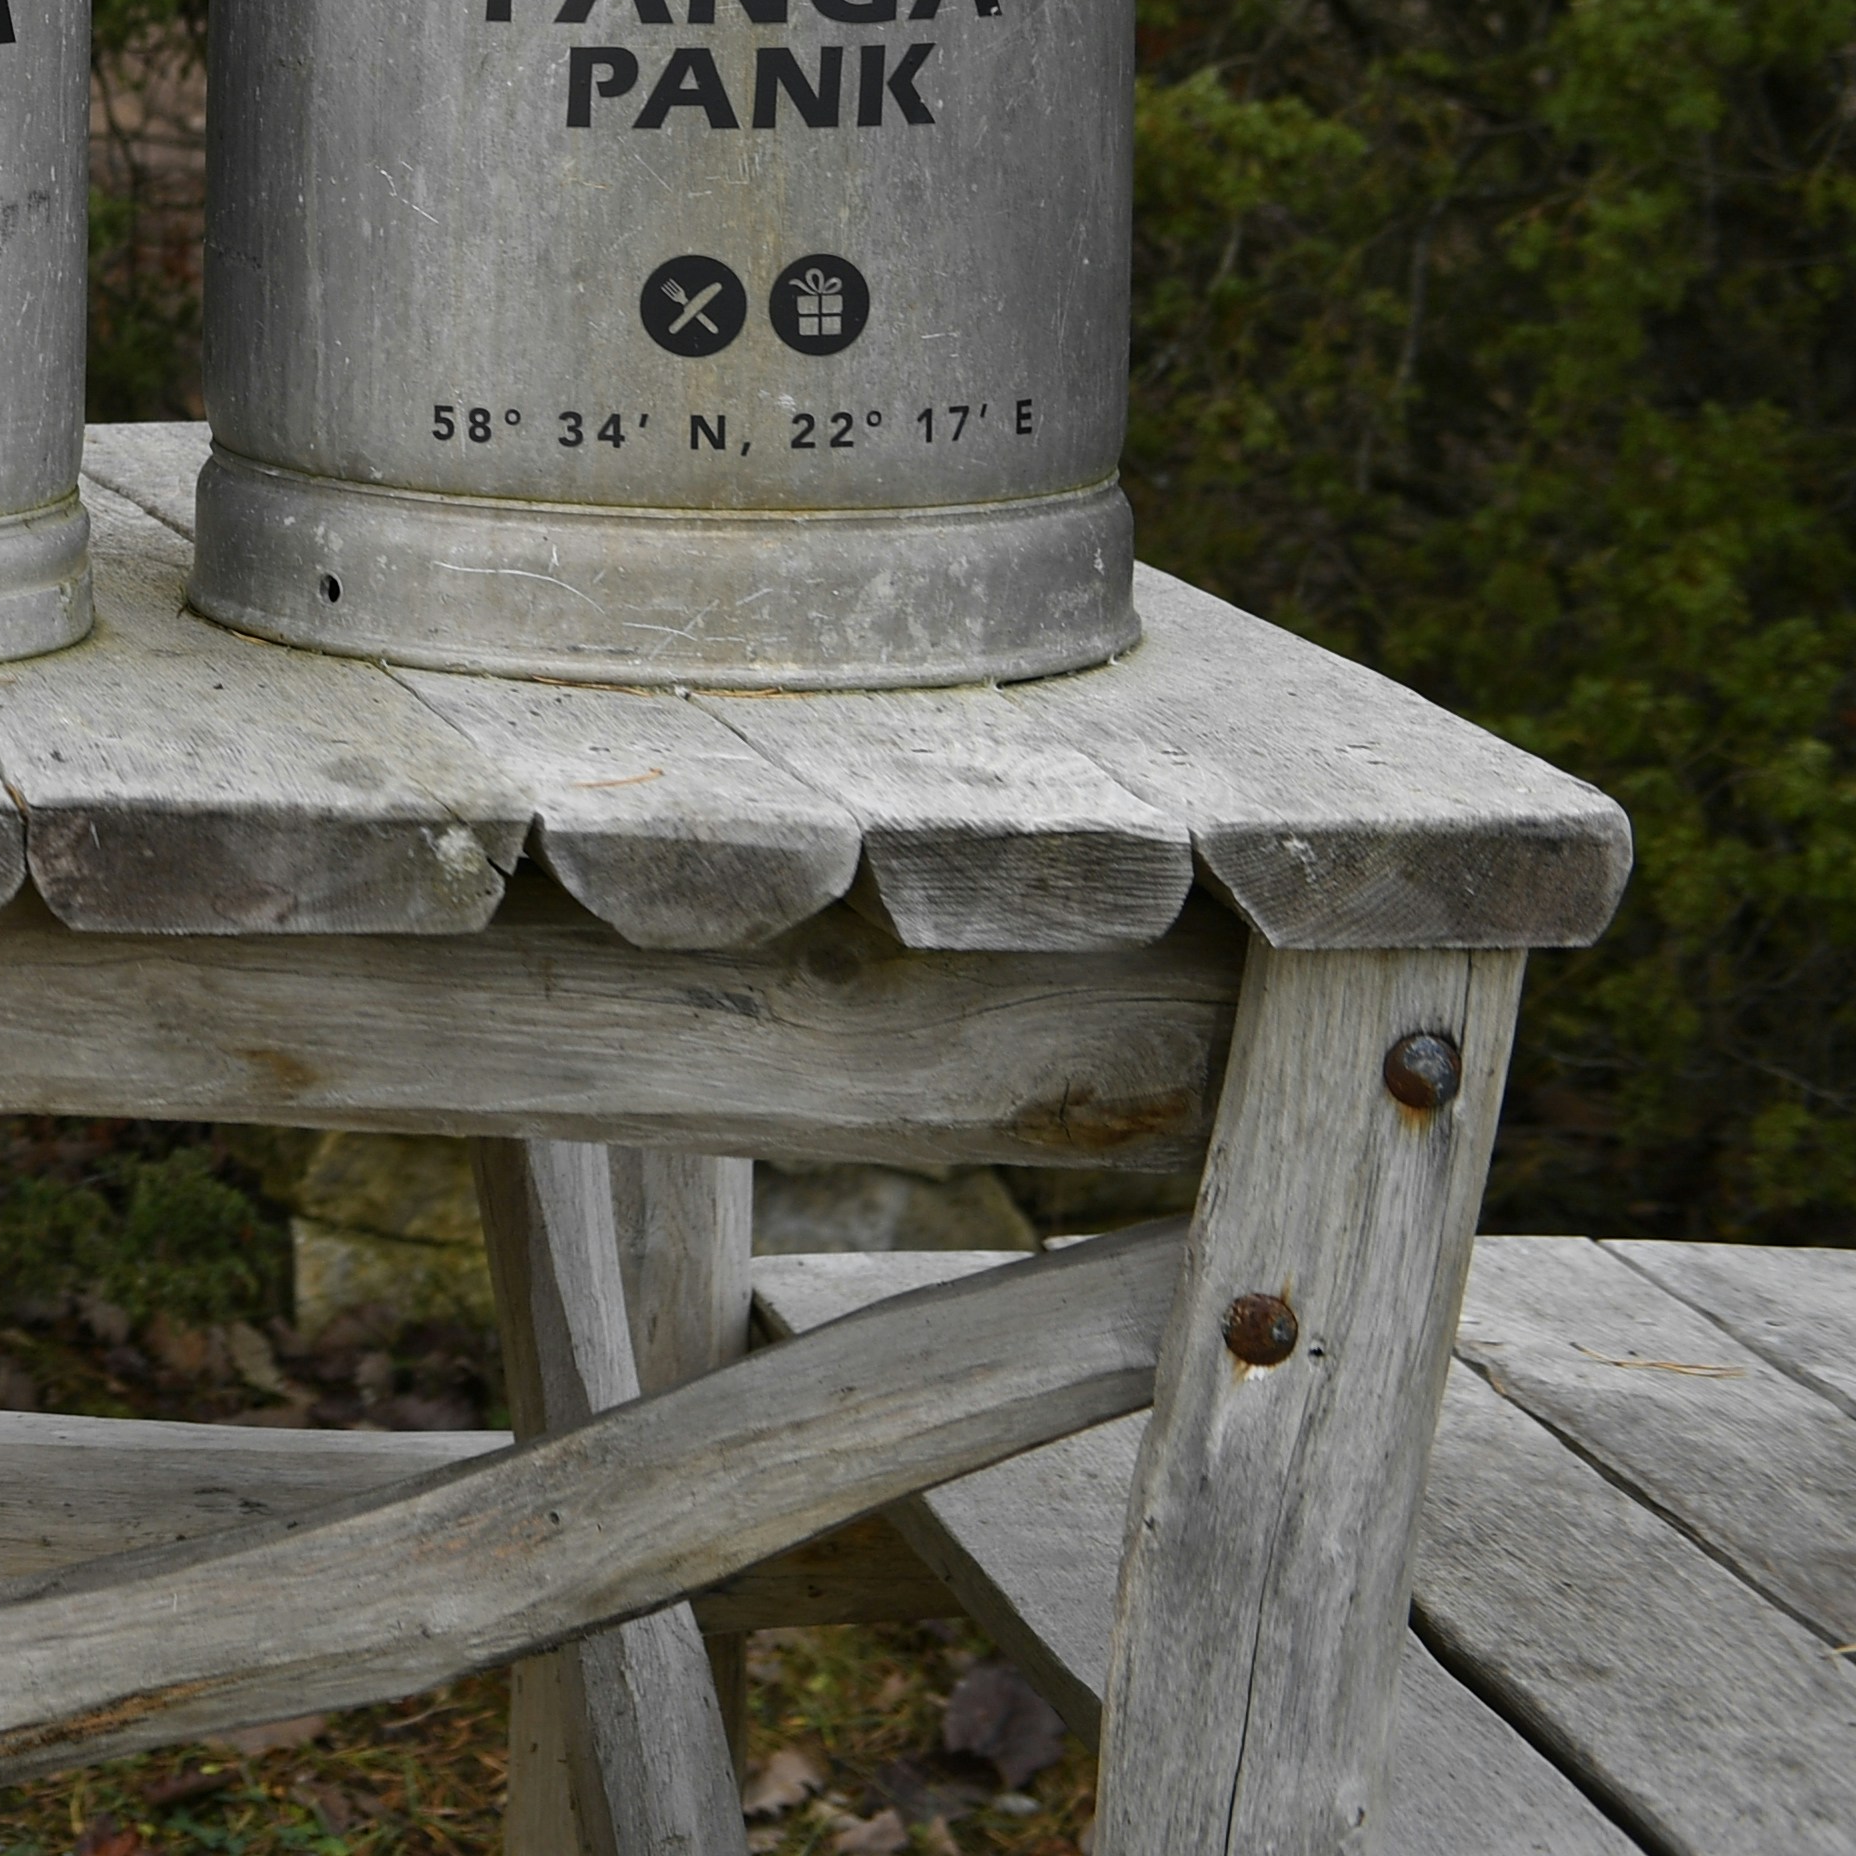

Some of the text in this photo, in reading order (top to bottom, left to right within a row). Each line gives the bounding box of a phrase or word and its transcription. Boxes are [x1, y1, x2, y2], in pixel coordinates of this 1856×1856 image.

[567, 43, 936, 129] PANK
[433, 405, 521, 443] 58°
[691, 415, 750, 456] N,
[791, 411, 881, 449] 22°
[1016, 399, 1032, 434] E
